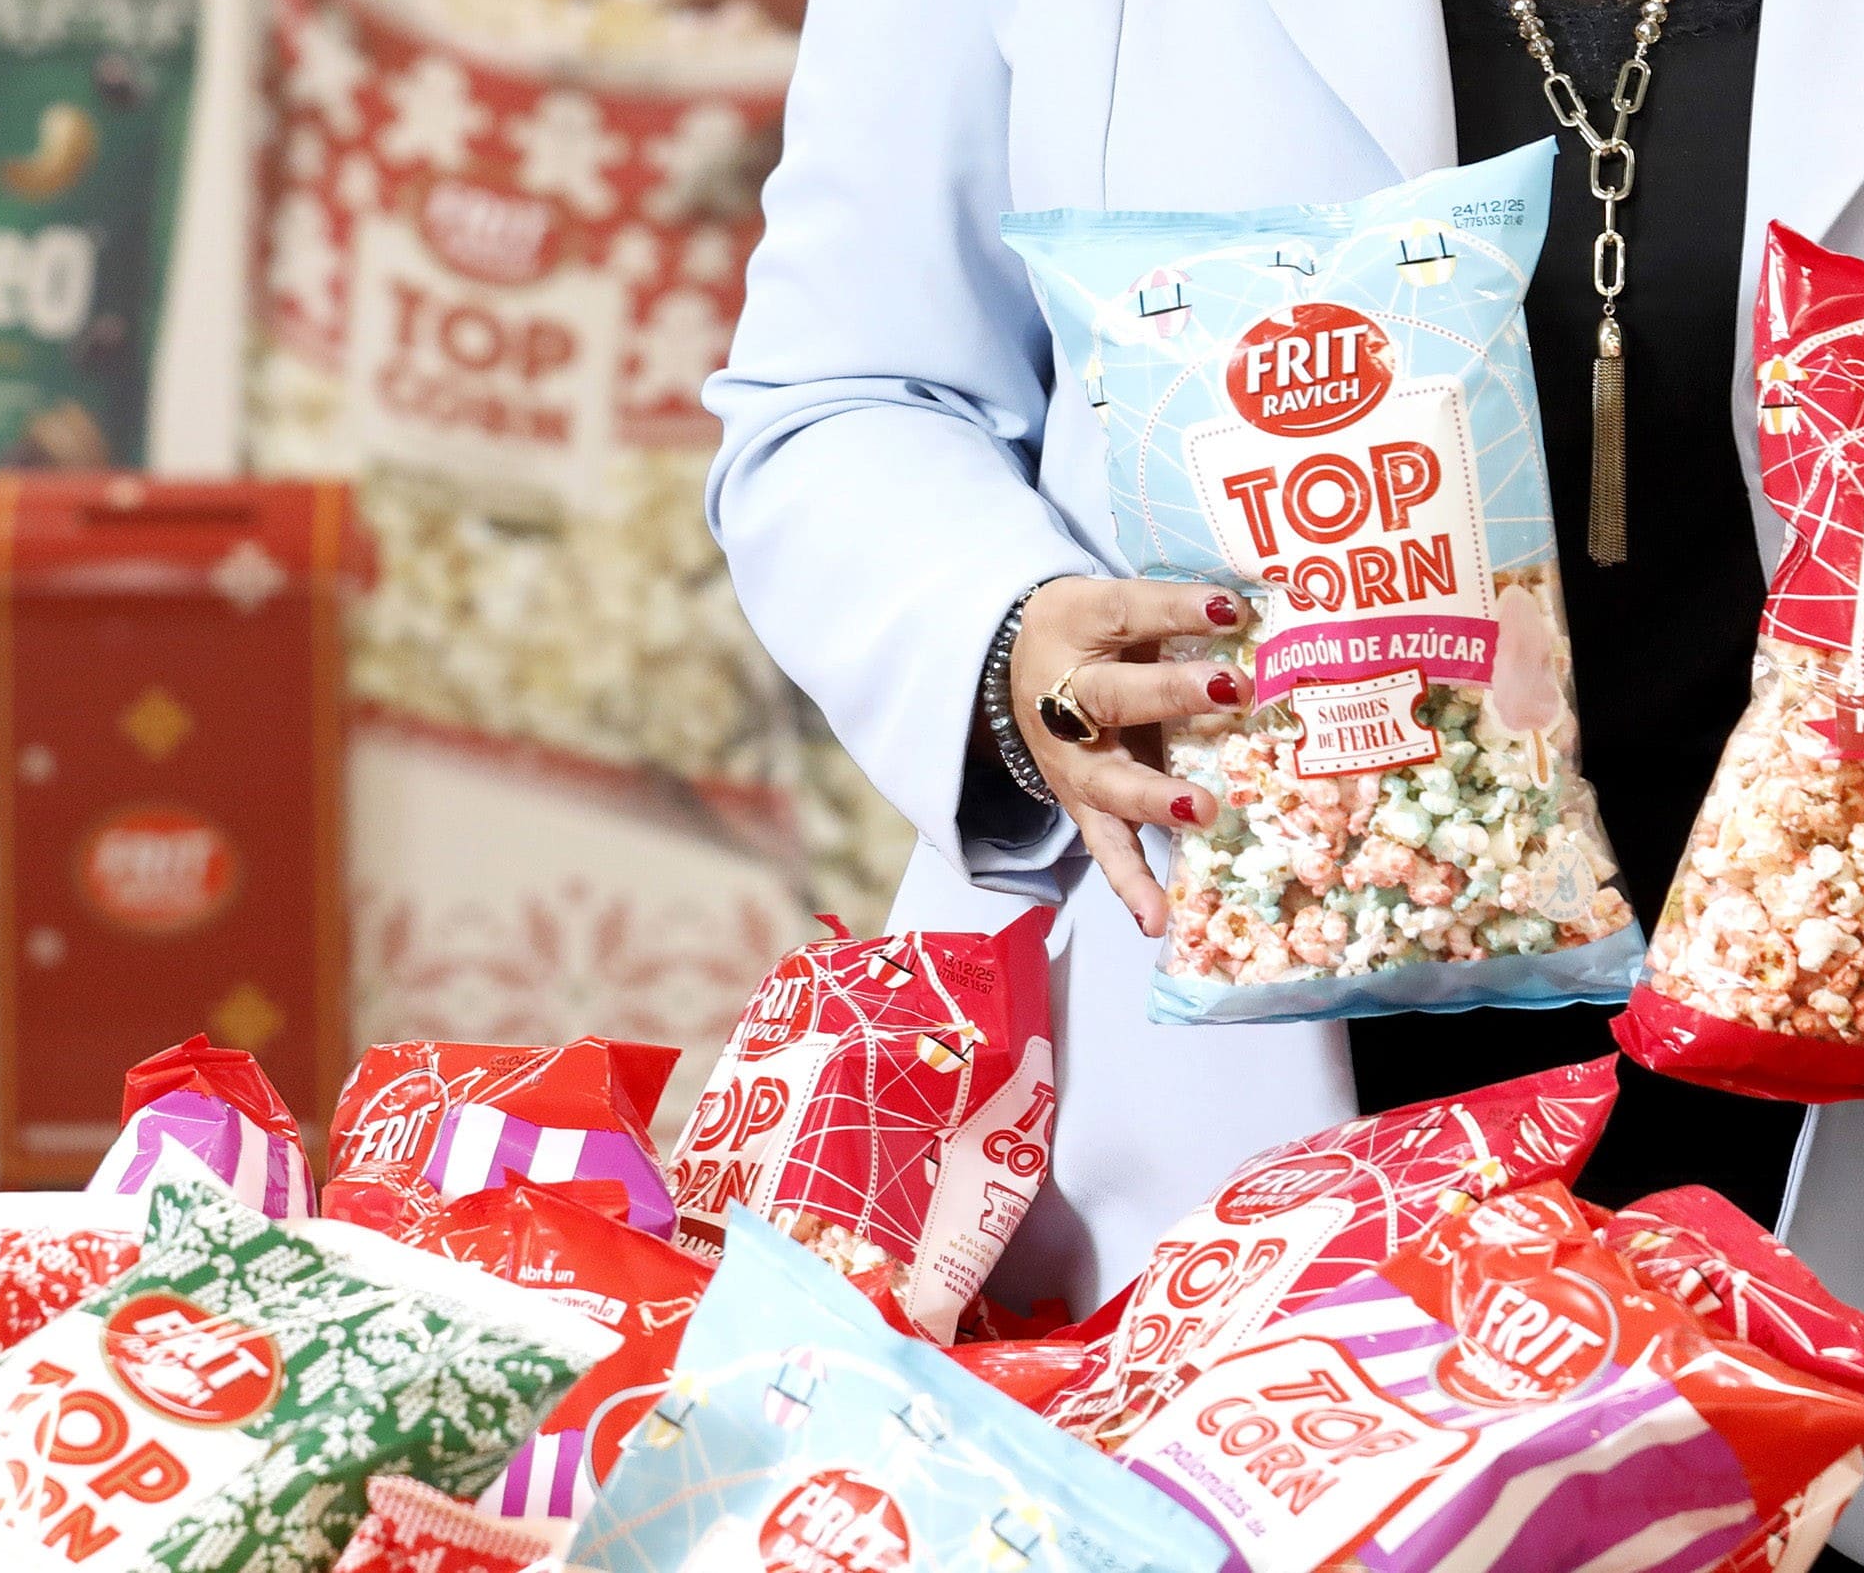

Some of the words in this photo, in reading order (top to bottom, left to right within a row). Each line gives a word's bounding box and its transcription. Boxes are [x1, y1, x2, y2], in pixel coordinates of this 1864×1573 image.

[1451, 199, 1526, 217] 24/12/25
[1245, 324, 1369, 394] FRIT
[1262, 378, 1360, 418] RAVICH
[1223, 440, 1442, 559] TOP
[1261, 533, 1458, 613] CORN
[1263, 632, 1344, 682] ALGODÓN
[1348, 635, 1383, 664] DE
[1387, 627, 1487, 664] AZÚCAR
[1318, 697, 1391, 725] SABORES
[1318, 732, 1336, 750] DE
[1337, 717, 1408, 754] FERIA
[942, 952, 996, 983] 13/12/25
[756, 976, 810, 1022] RIT
[346, 1101, 441, 1169] FRIT
[1236, 1168, 1347, 1196] FRIT
[517, 1261, 553, 1283] Abre
[554, 1269, 576, 1284] un
[1476, 1284, 1605, 1377] FRIT
[1257, 1369, 1420, 1466] TOP
[1196, 1397, 1341, 1517] CORN
